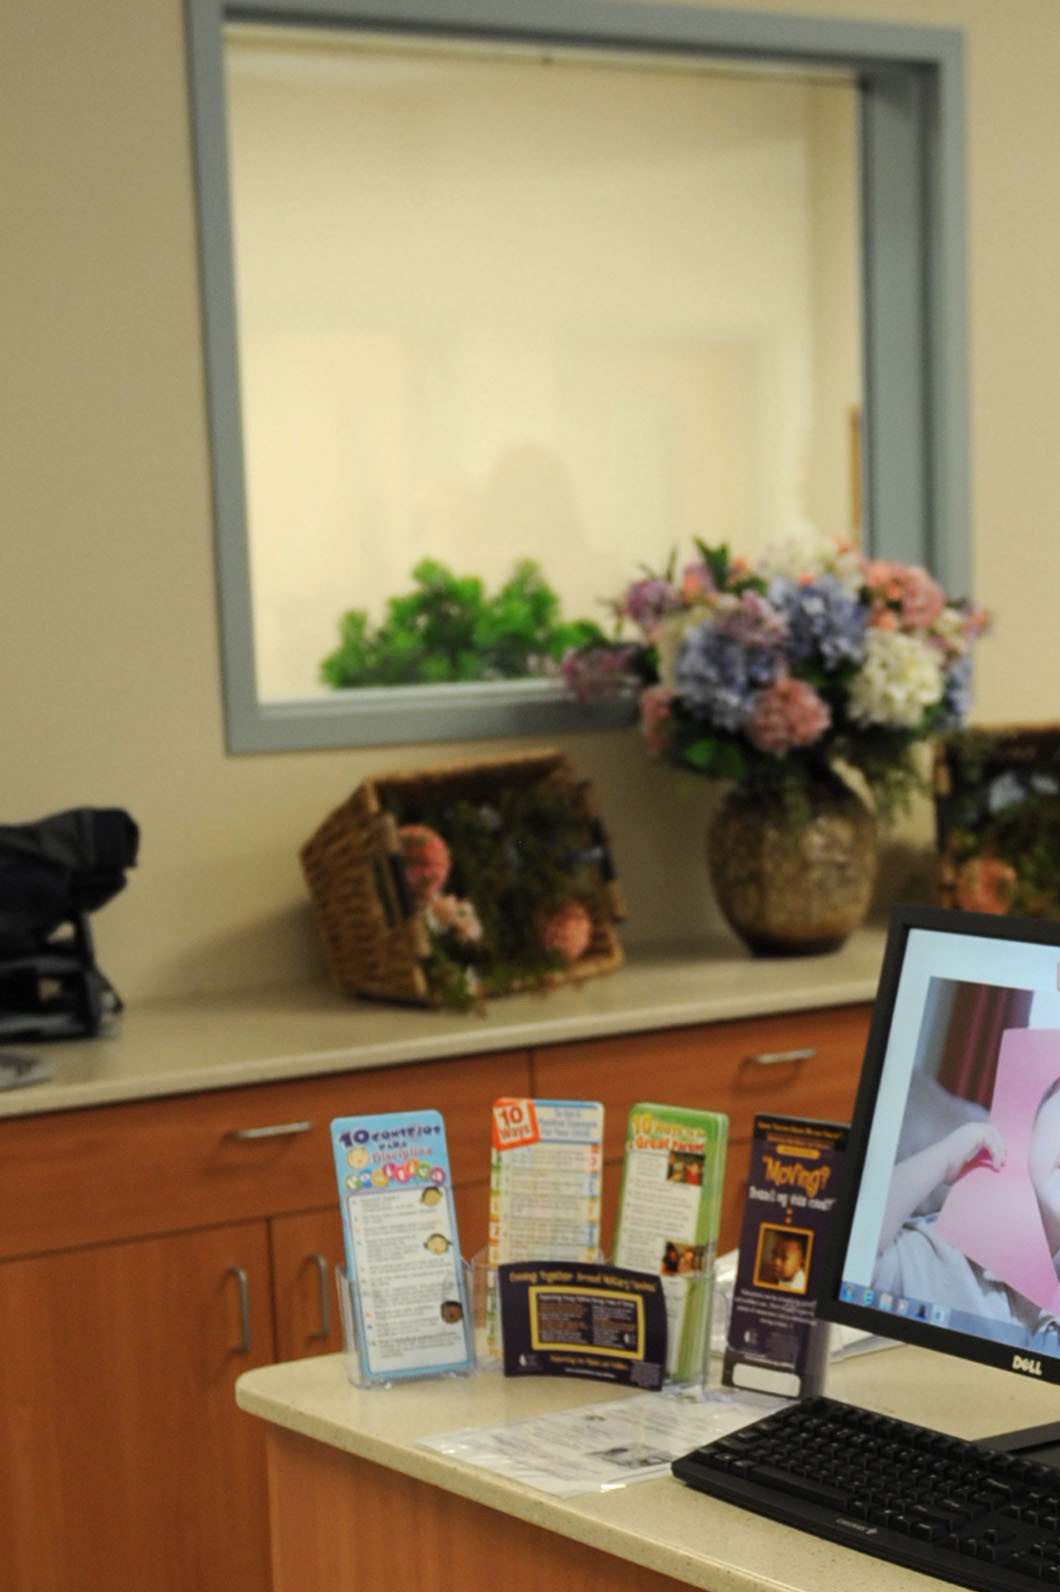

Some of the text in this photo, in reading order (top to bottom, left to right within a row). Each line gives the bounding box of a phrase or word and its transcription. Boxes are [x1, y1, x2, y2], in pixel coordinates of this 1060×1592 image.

[500, 1106, 523, 1124] 10
[632, 1113, 653, 1134] 10
[340, 1129, 370, 1148] 10
[500, 1126, 531, 1139] Ways
[636, 1135, 669, 1149] Great
[1012, 1354, 1043, 1376] DELL
